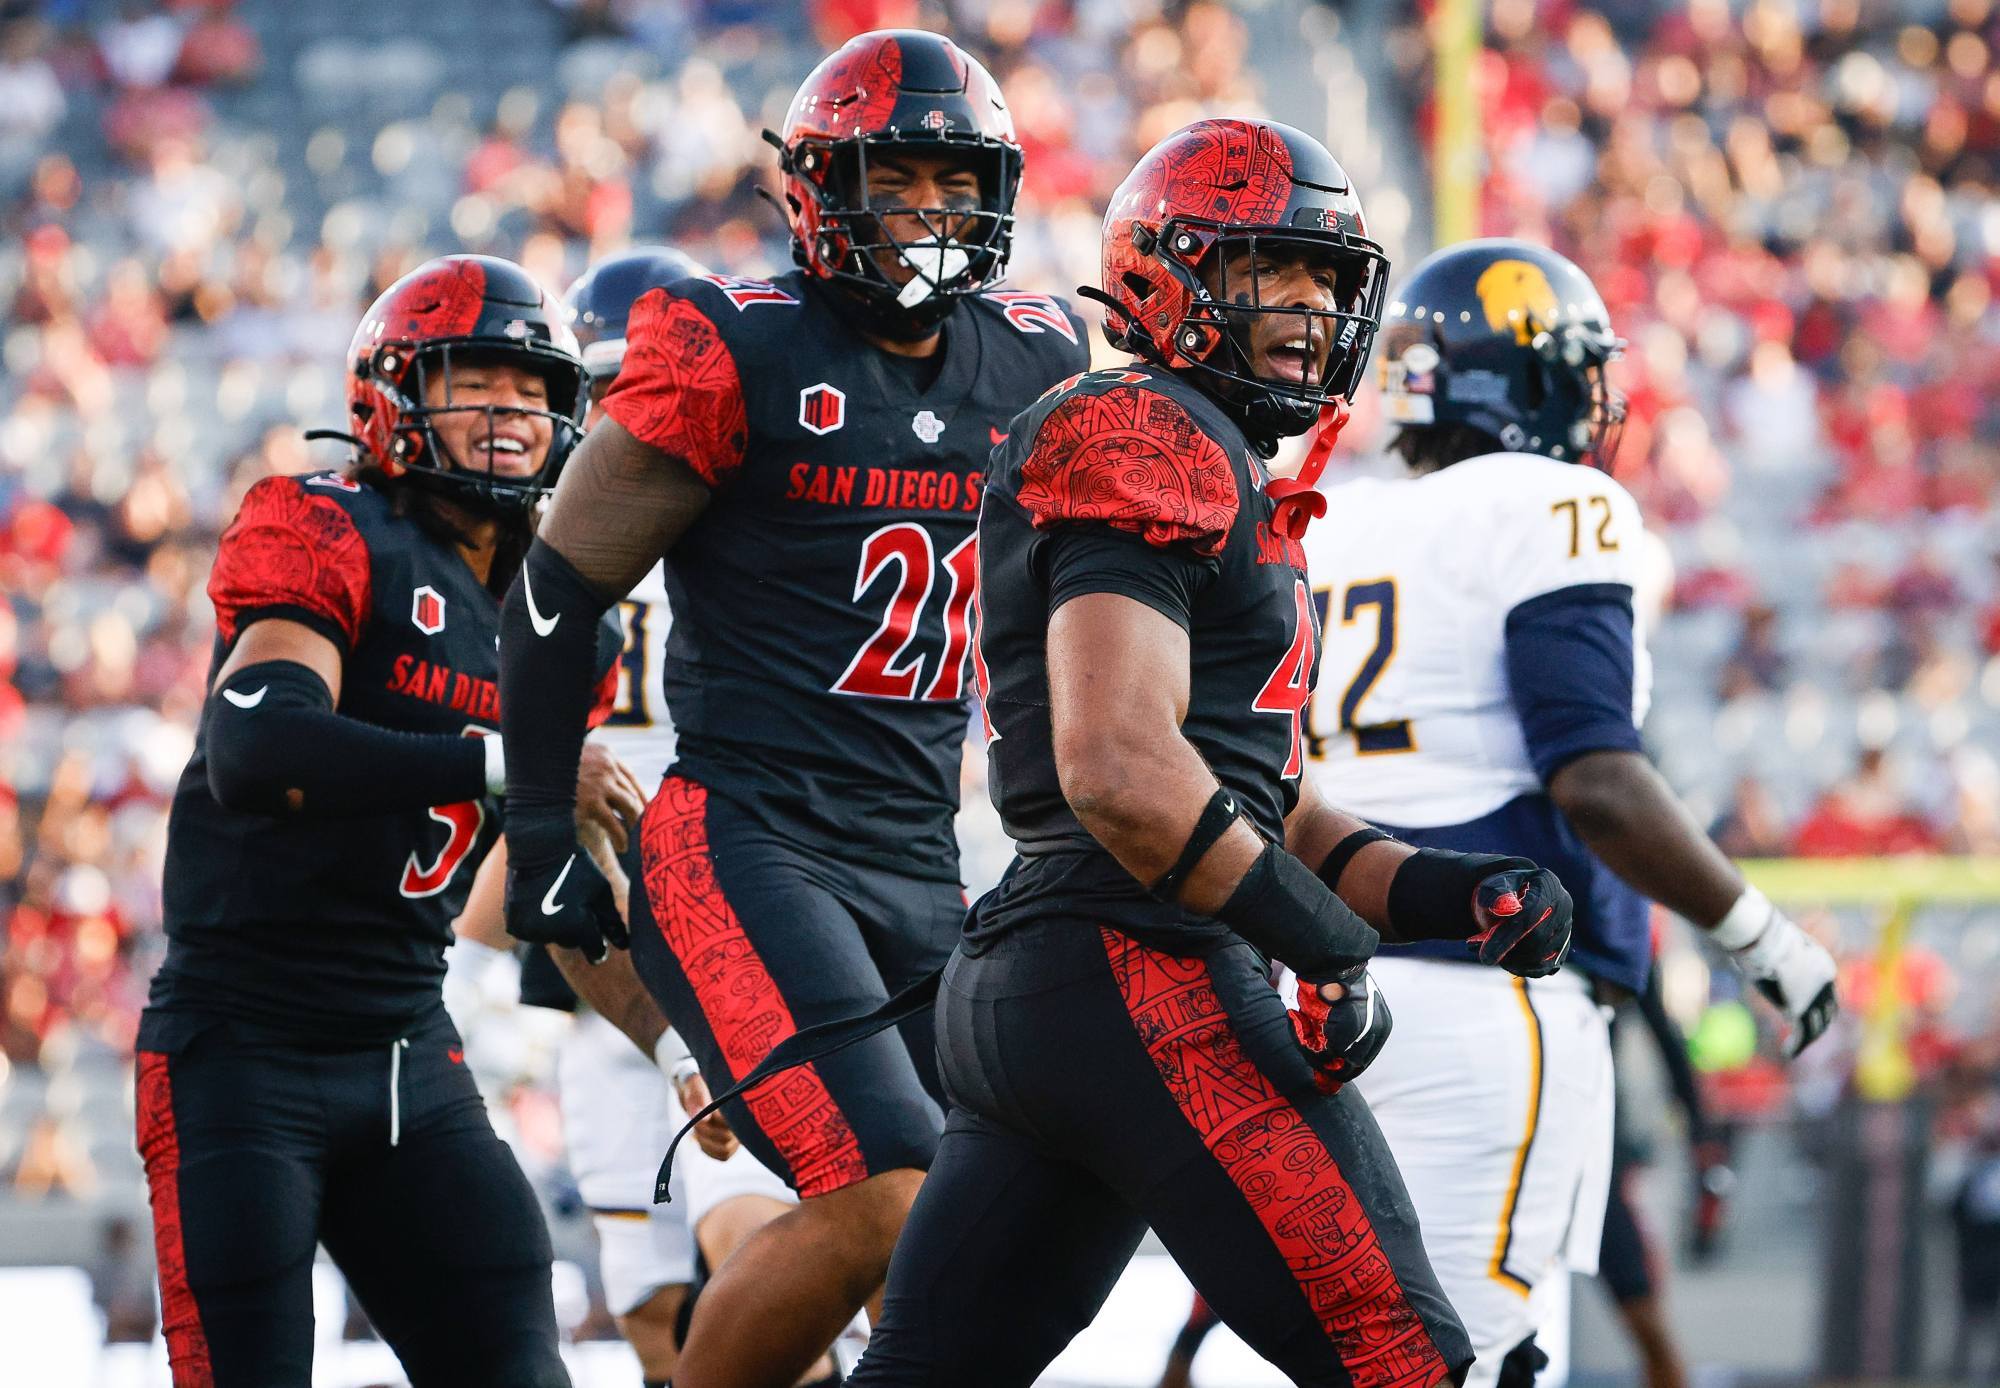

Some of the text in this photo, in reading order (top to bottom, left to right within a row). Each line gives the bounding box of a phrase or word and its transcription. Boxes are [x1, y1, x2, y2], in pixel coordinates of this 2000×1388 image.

[785, 463, 858, 505] SAN
[862, 468, 959, 512] DIEGO
[1551, 495, 1619, 558] 72
[829, 522, 980, 701] 21
[386, 654, 450, 704] SAN
[1252, 578, 1315, 780] 4
